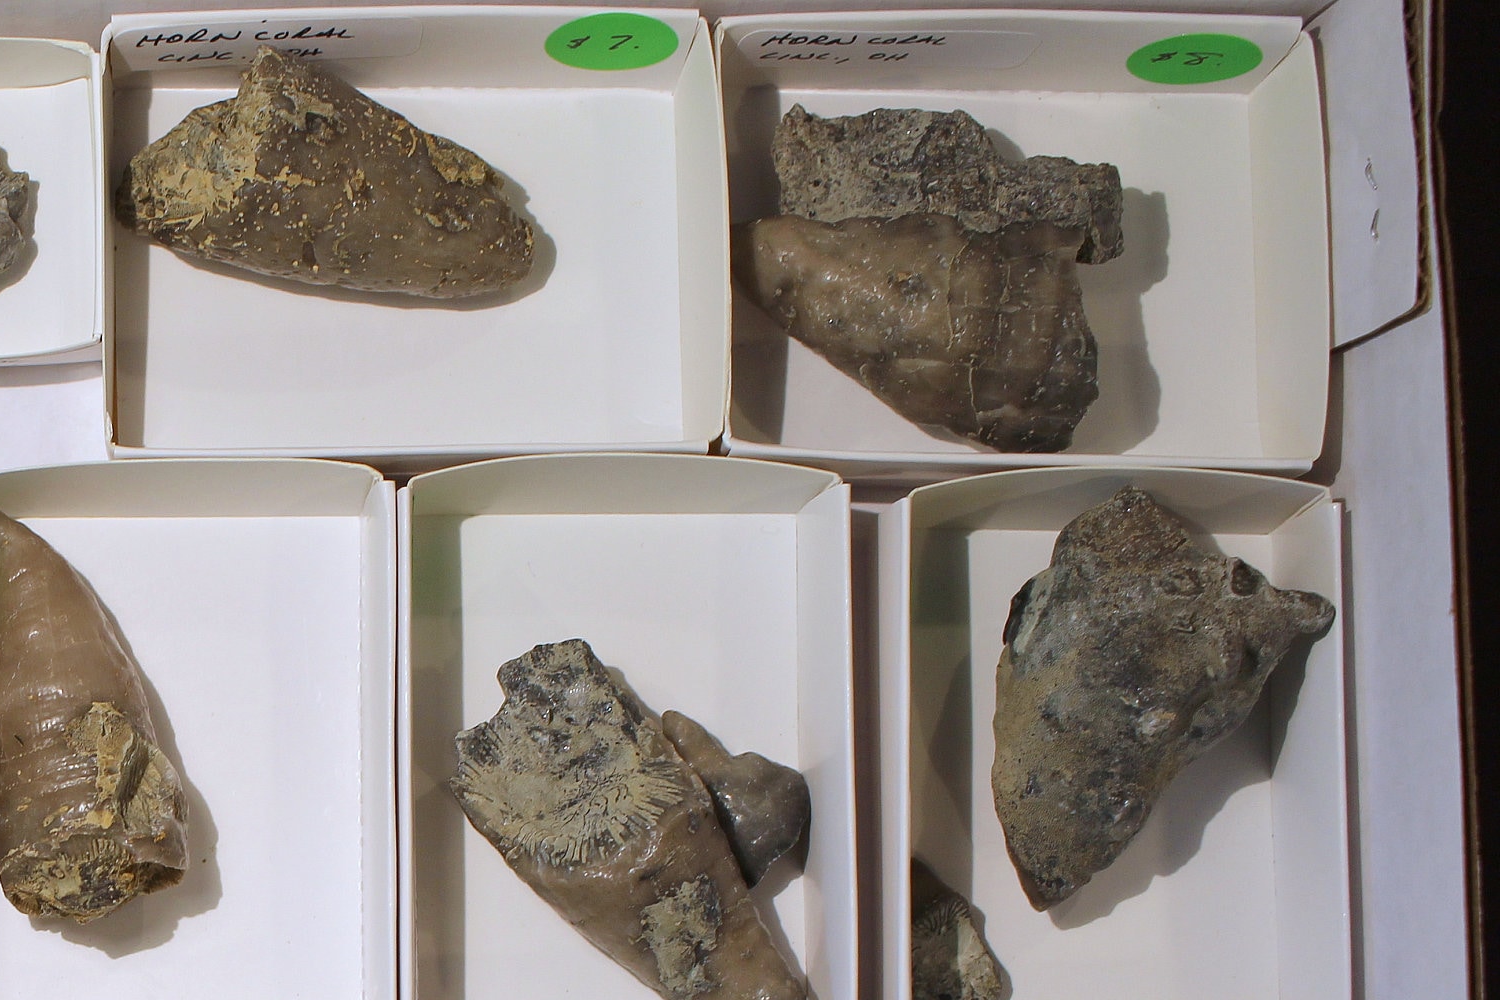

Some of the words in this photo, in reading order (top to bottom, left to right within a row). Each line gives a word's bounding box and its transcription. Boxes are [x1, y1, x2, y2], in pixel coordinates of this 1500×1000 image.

[135, 27, 243, 49] HORN
[253, 25, 356, 42] CORAL
[760, 31, 858, 47] HORN
[866, 35, 948, 46] CORAL
[867, 52, 910, 62] OH
